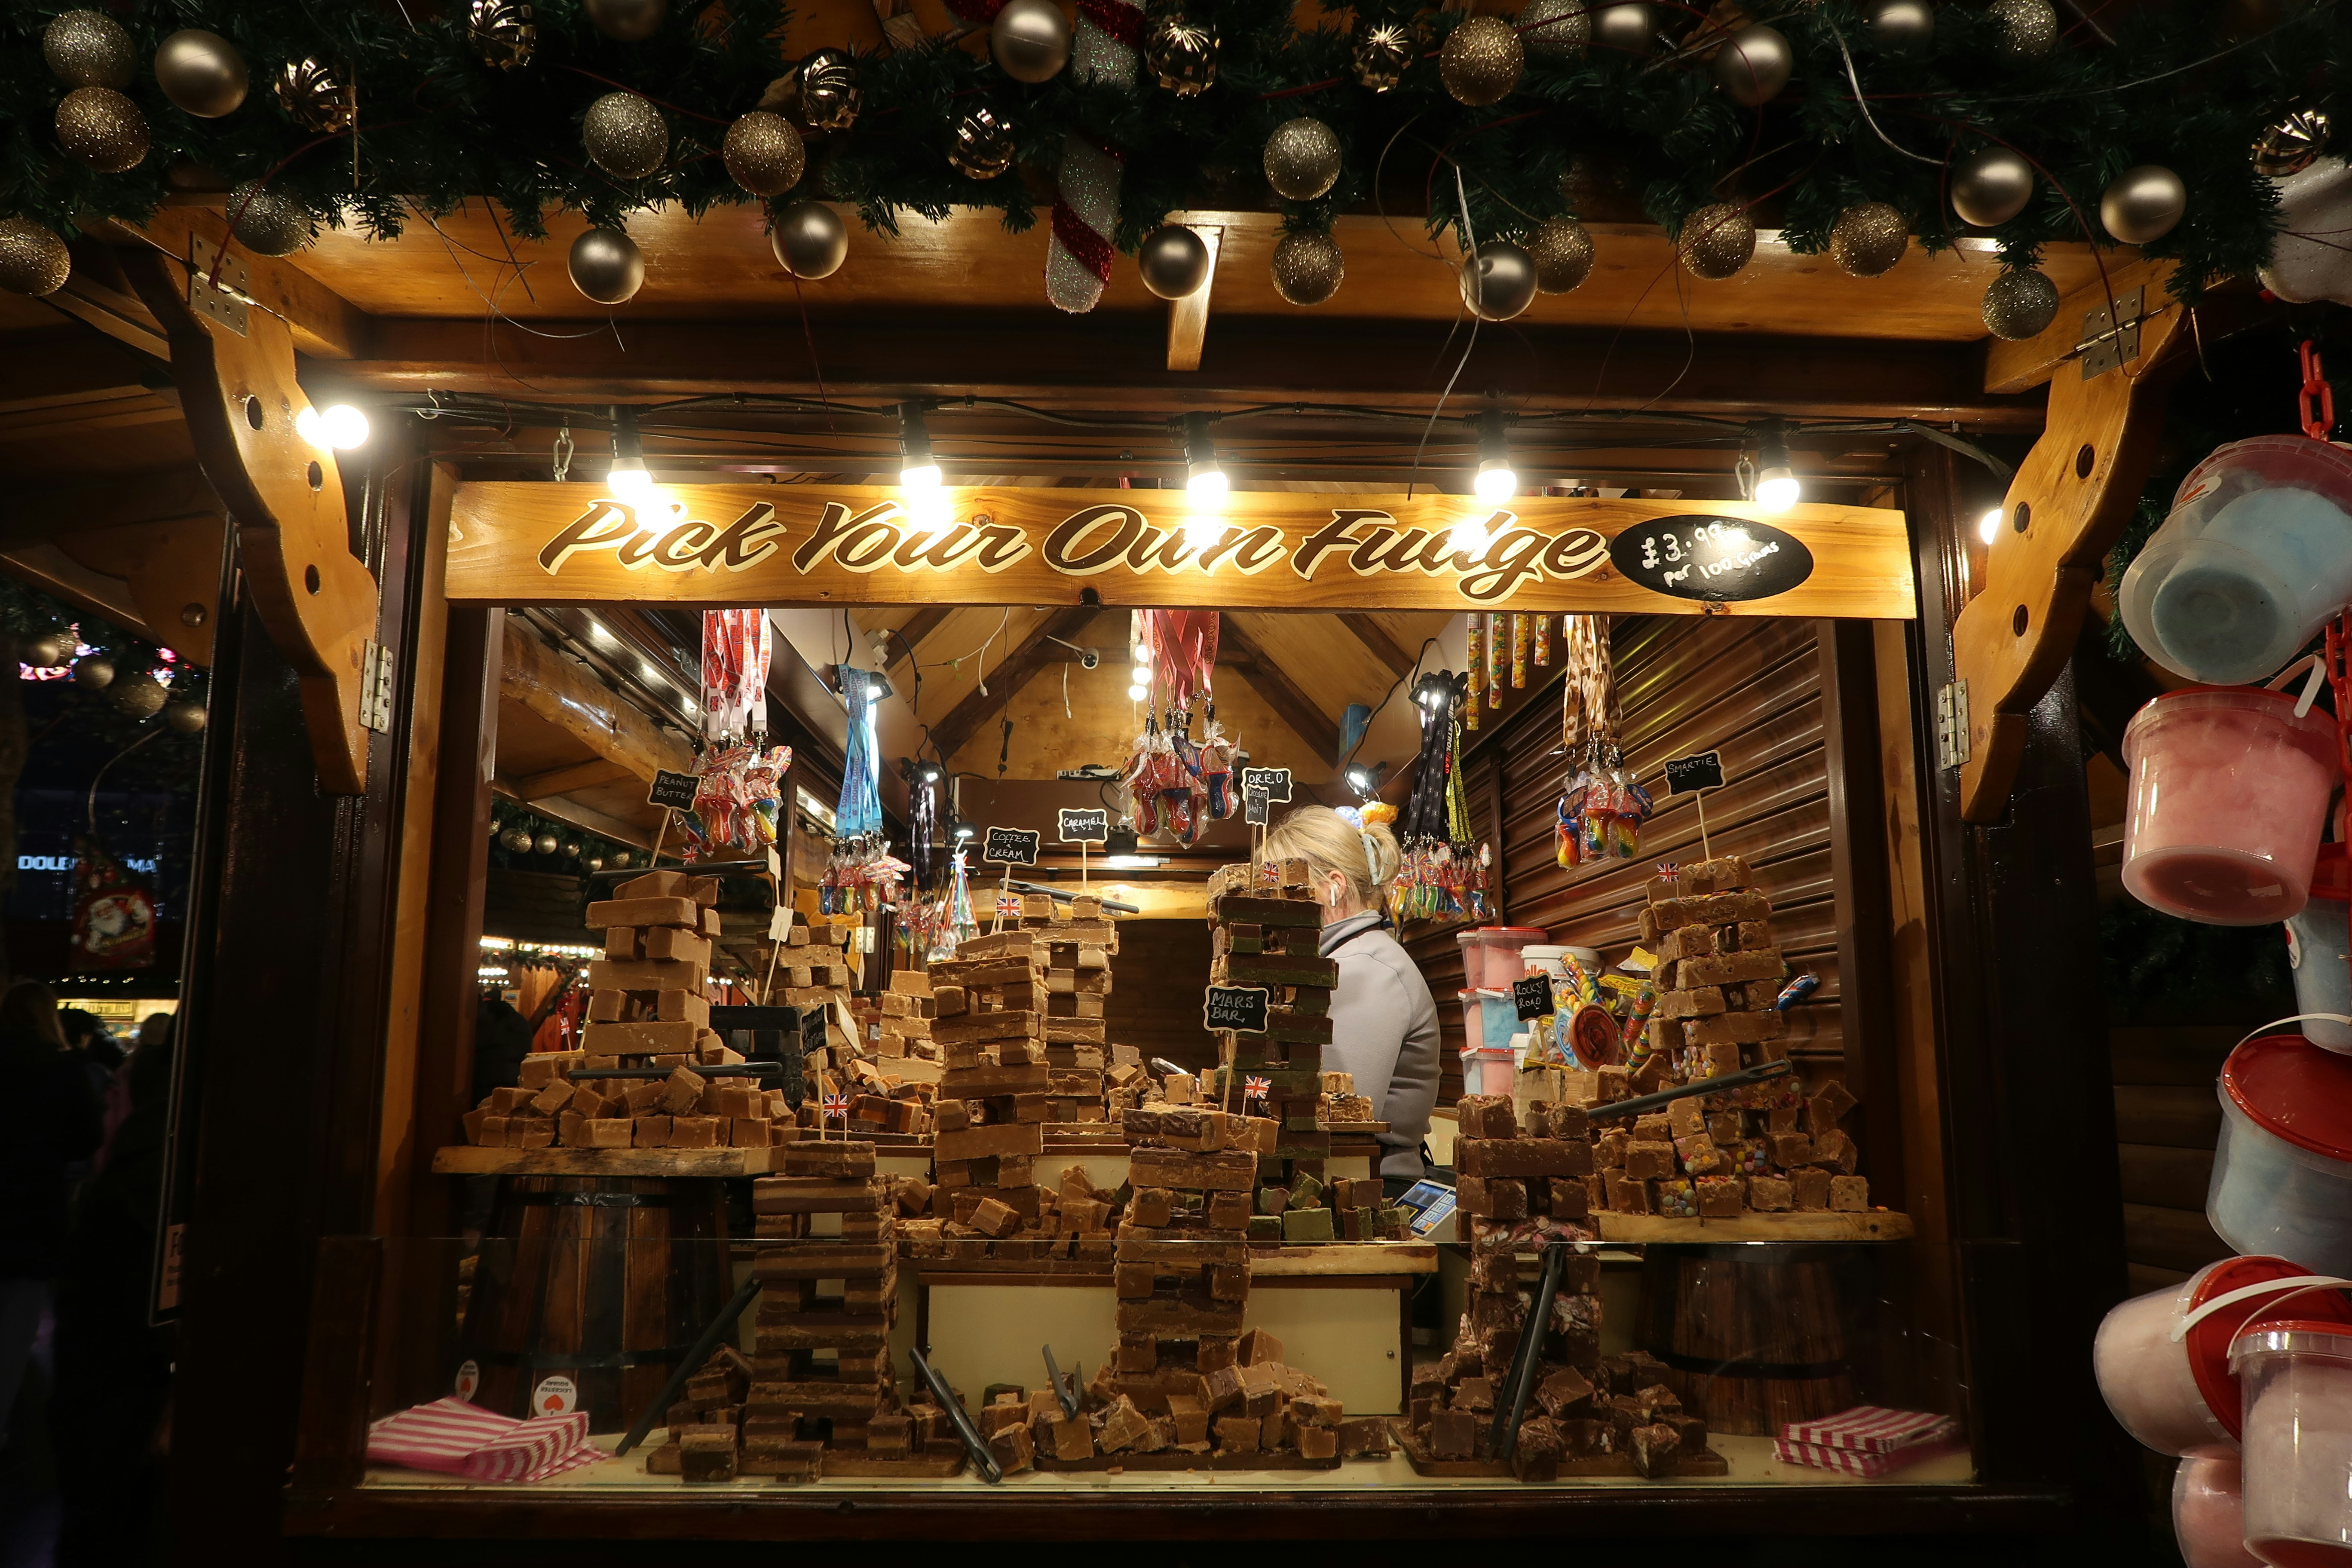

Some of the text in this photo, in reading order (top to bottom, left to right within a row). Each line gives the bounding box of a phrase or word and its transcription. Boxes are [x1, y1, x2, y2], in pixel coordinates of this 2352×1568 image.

[537, 499, 1611, 606] Pick Your Own Fudge
[1663, 541, 1780, 588] per 100 Grams
[1668, 756, 1716, 777] SMARTIE
[658, 775, 695, 789] PEANUT
[1248, 772, 1283, 784] OREO
[656, 787, 693, 800] BUTTER
[1063, 816, 1105, 832] CARAMEL
[992, 832, 1030, 843] COFFEE
[989, 848, 1029, 862] CREAM
[1515, 981, 1544, 996] ROCKY
[1210, 992, 1254, 1008] MARS
[1517, 997, 1541, 1010] ROAD
[1211, 1007, 1245, 1023] BAR
